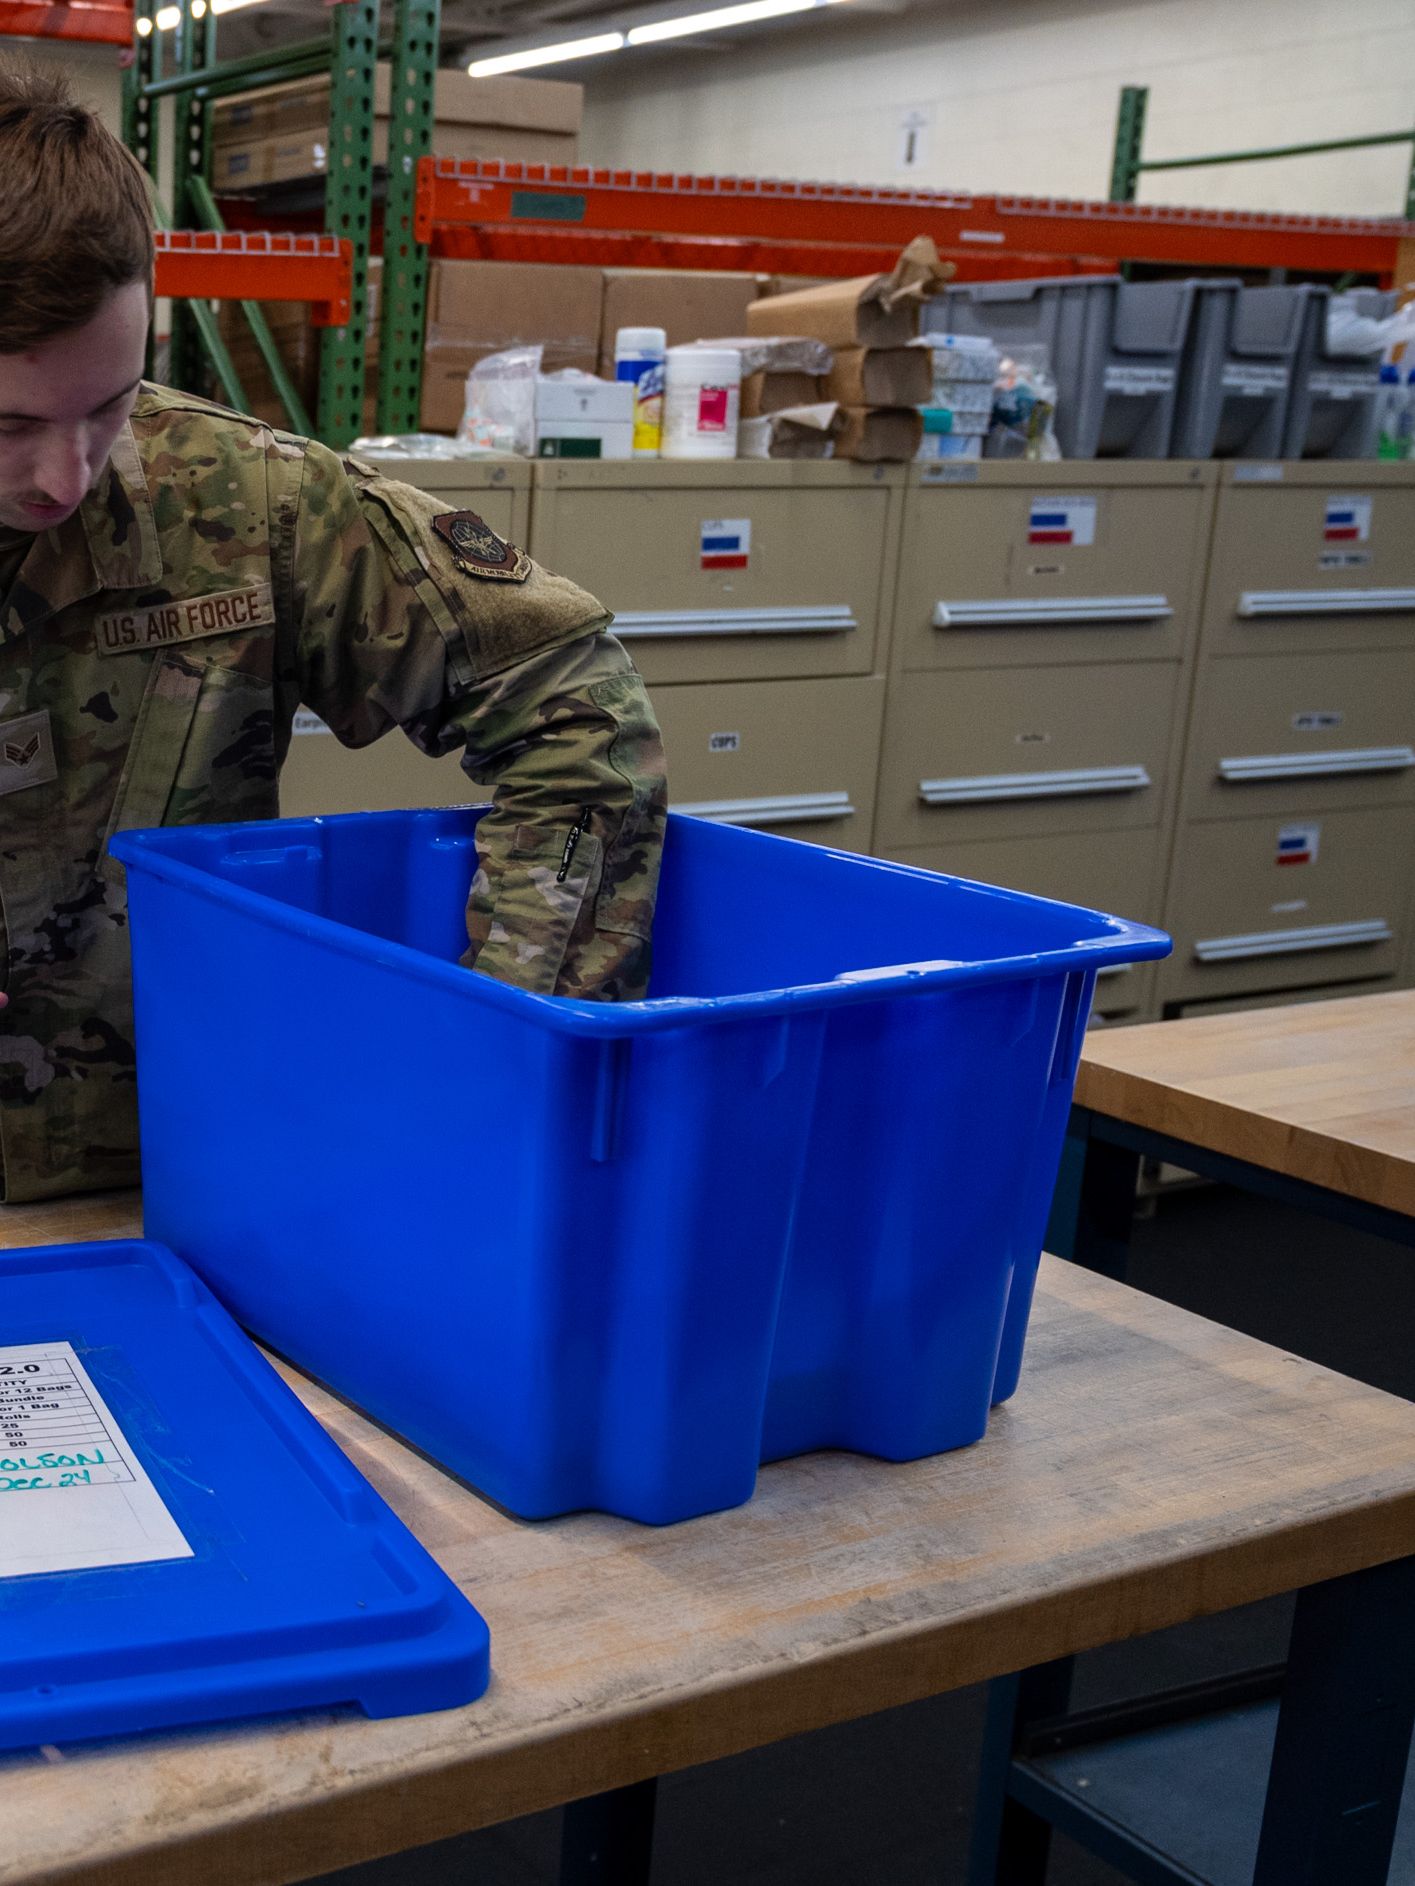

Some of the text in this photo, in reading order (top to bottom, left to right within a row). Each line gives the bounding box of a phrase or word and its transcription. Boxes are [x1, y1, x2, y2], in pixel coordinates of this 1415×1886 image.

[102, 592, 262, 648] U.S. AIR FORCE
[711, 735, 737, 749] CUPS
[37, 1384, 73, 1392] Bags
[31, 1402, 60, 1410] Bag
[59, 1469, 92, 1488] 24
